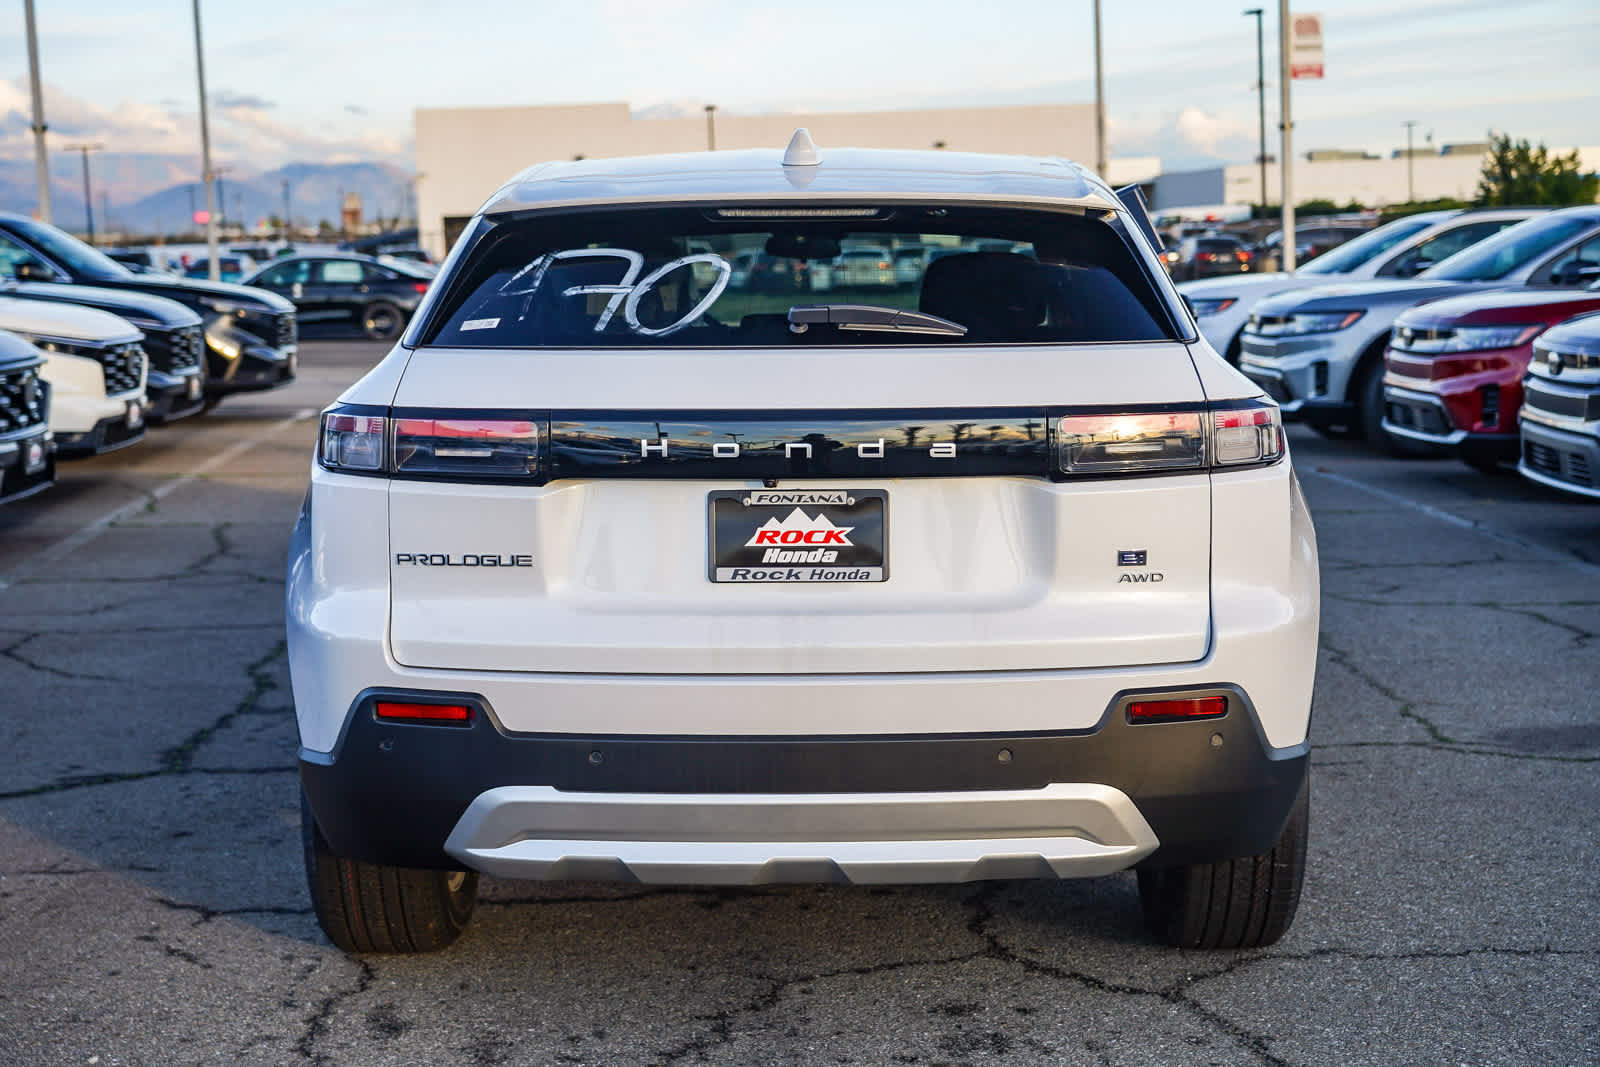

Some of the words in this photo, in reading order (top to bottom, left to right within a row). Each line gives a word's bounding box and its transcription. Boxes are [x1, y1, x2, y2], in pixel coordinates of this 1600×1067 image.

[756, 494, 844, 504] FONTANA
[755, 530, 848, 544] ROCK
[396, 553, 533, 567] PROLOGUE
[761, 548, 839, 563] Honda
[730, 568, 803, 580] Rock
[809, 568, 871, 580] Honda
[1118, 573, 1164, 583] AWD
